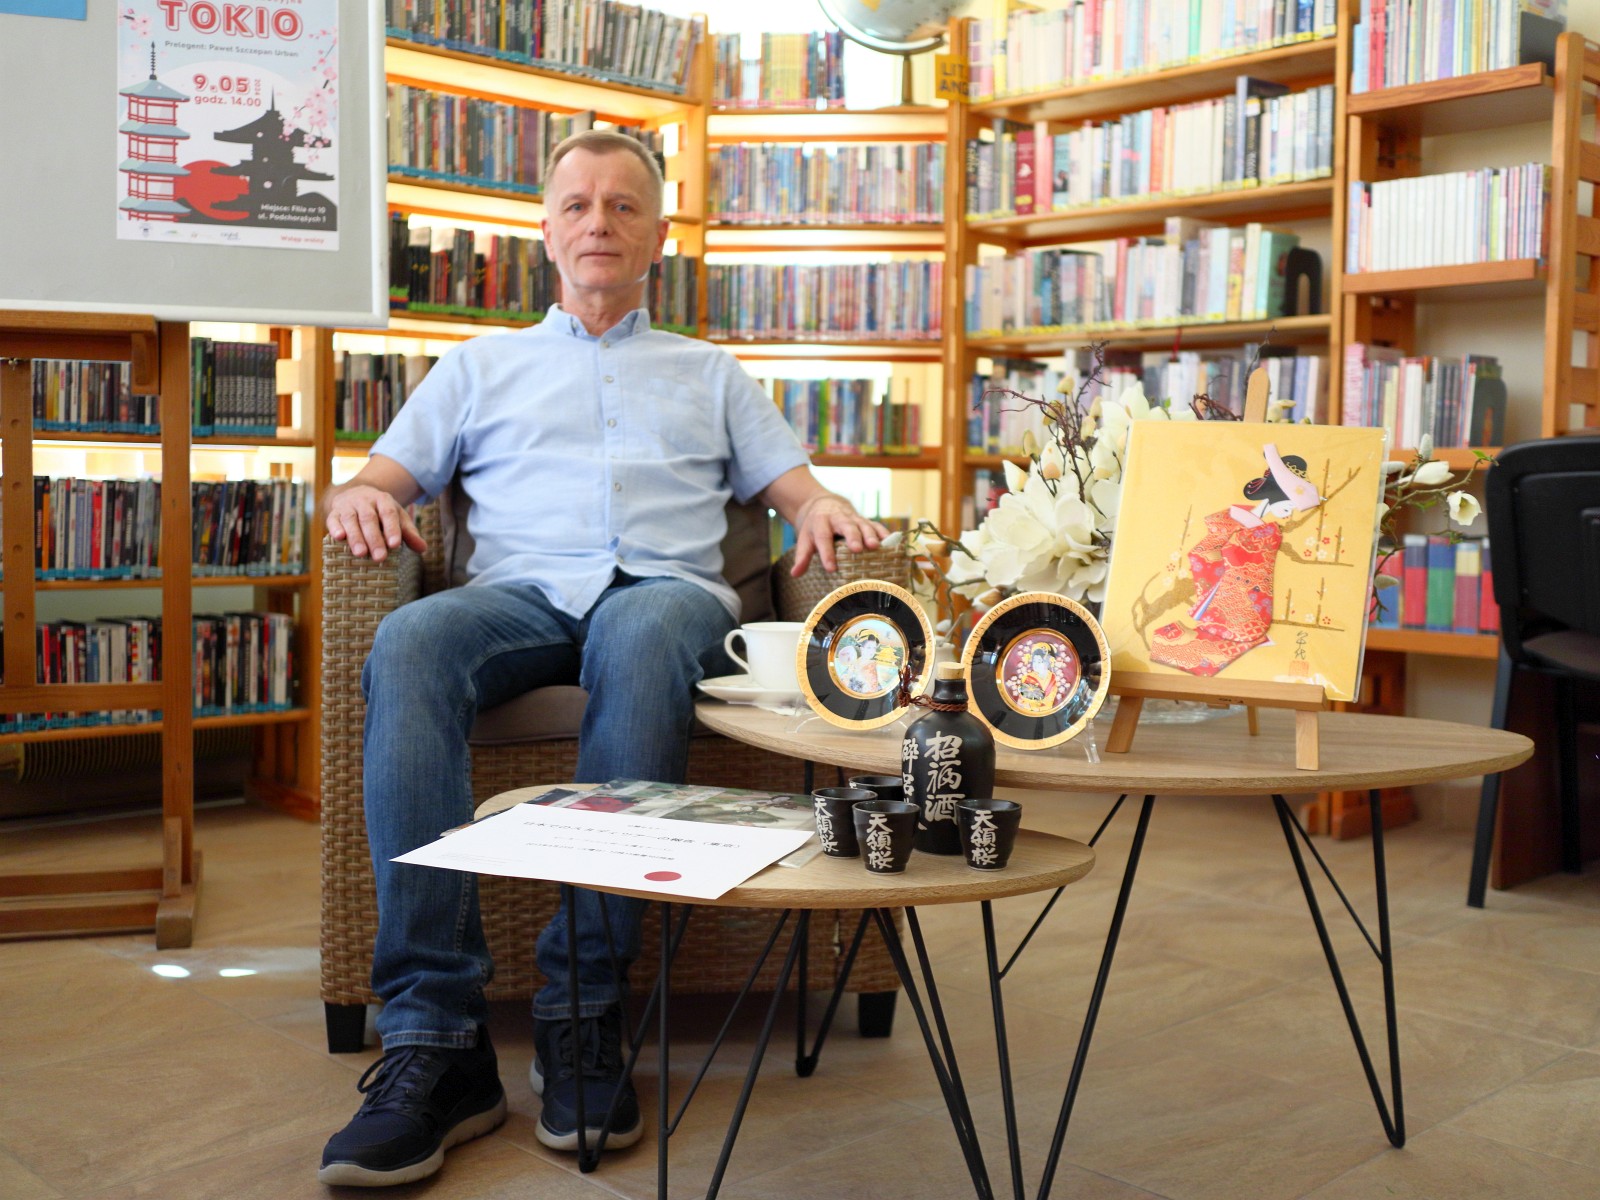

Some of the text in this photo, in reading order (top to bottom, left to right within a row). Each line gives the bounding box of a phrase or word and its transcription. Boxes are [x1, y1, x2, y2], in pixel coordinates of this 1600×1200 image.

[157, 0, 303, 41] TOKIO
[165, 40, 206, 51] Prelegent:
[235, 46, 273, 57] Szczepan
[275, 49, 299, 57] Urban
[193, 73, 250, 95] 9.05
[194, 95, 262, 107] godz. 14.00
[866, 813, 894, 869] 天領桜
[970, 810, 999, 866] 天領桜
